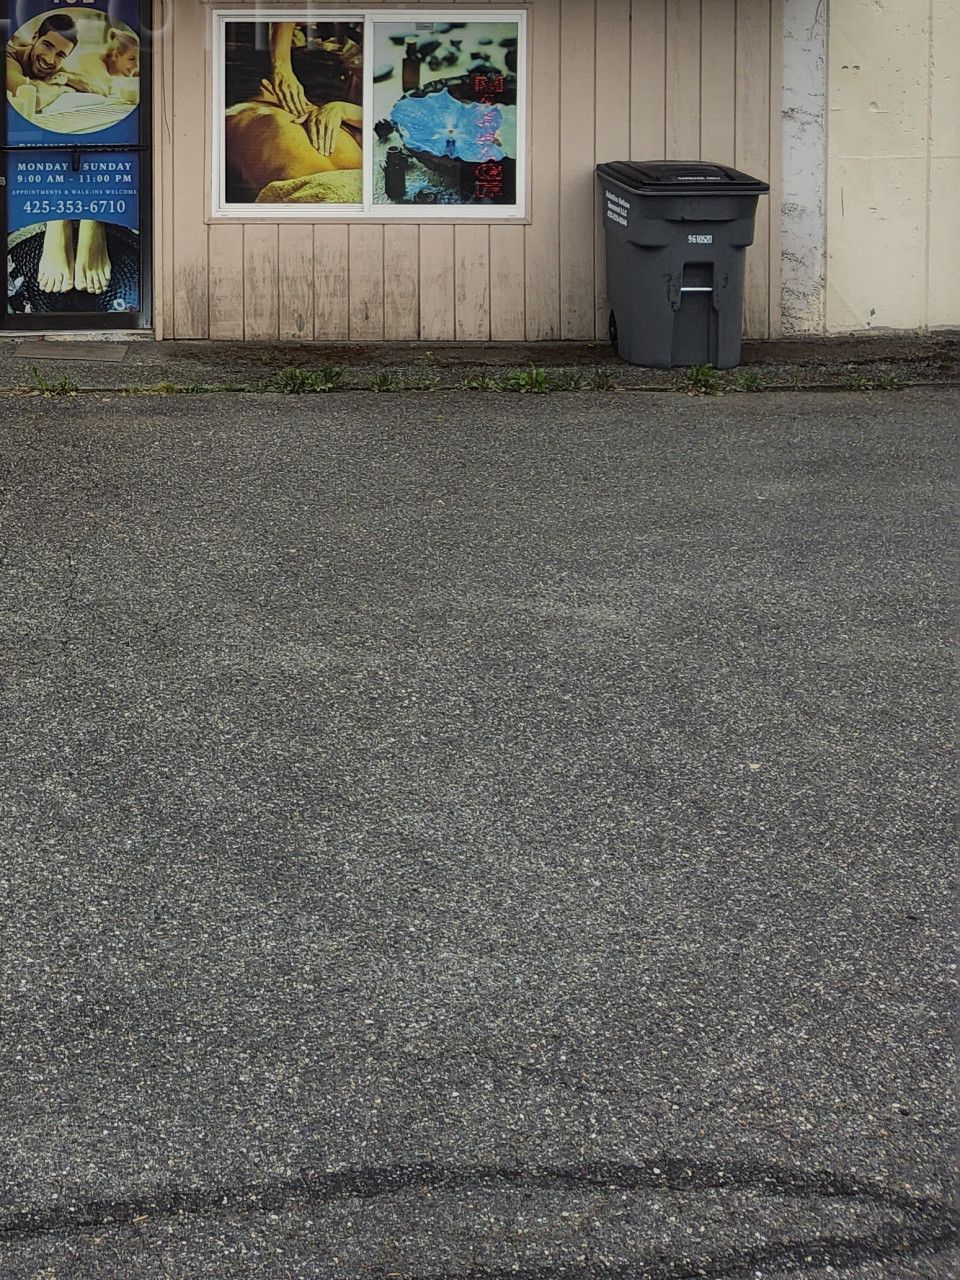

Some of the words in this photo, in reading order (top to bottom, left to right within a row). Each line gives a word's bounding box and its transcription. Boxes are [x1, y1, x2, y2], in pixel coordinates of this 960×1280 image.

[17, 162, 69, 171] MONDAY
[83, 162, 131, 171] SUNDAY
[17, 174, 42, 183] 9:00
[46, 174, 64, 183] AM
[79, 174, 110, 183] 11:00
[115, 174, 132, 183] PM
[23, 200, 126, 214] 425-353-6710
